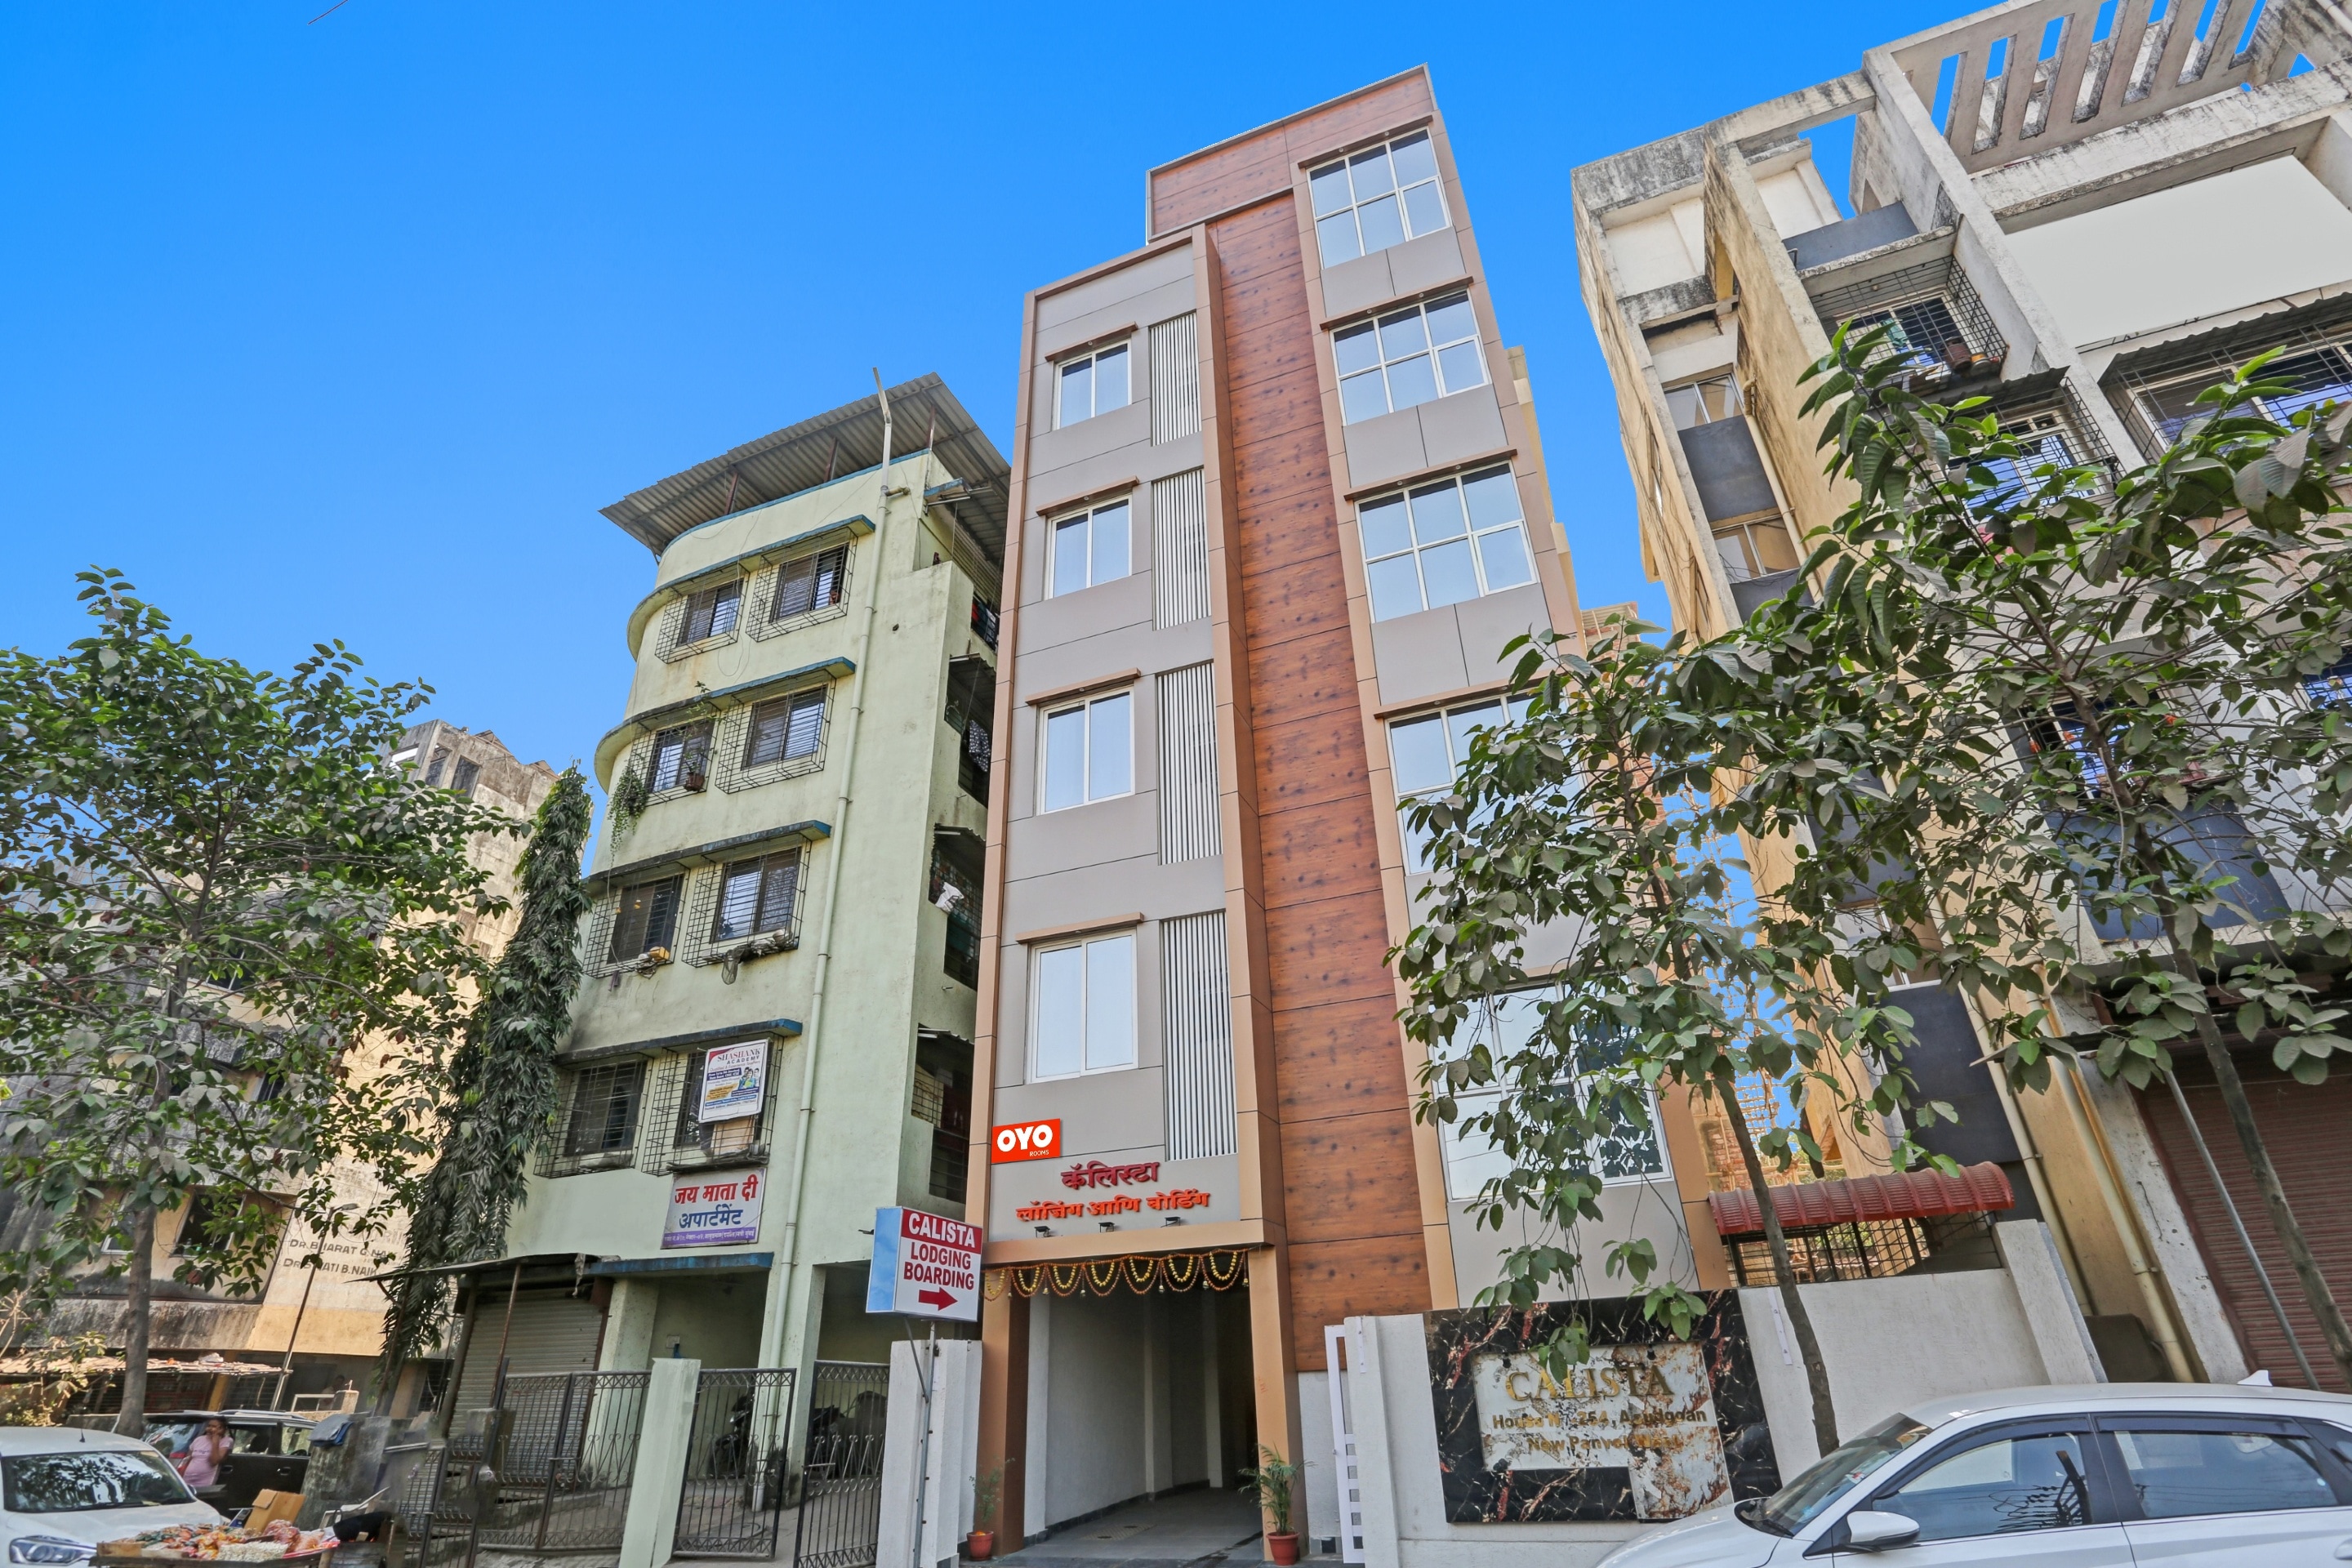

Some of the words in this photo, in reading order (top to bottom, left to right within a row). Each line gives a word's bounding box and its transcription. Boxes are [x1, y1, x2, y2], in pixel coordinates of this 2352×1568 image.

[718, 1048, 760, 1061] SHASHANK
[727, 1055, 760, 1064] ACADEMY
[997, 1124, 1053, 1152] OYO
[1029, 1149, 1049, 1157] ROOMS
[675, 1186, 700, 1204] जय
[702, 1183, 738, 1202] माता
[742, 1174, 759, 1201] दी
[679, 1203, 744, 1228] अपार्टमेंट
[1087, 1194, 1142, 1216] आणि
[908, 1213, 975, 1248] CALISTA
[911, 1241, 971, 1270] LODGING
[903, 1261, 974, 1290] BOARDING
[1505, 1365, 1675, 1401] CALISTA
[1526, 1437, 1565, 1451] New
[1569, 1434, 1628, 1451] Panvel
